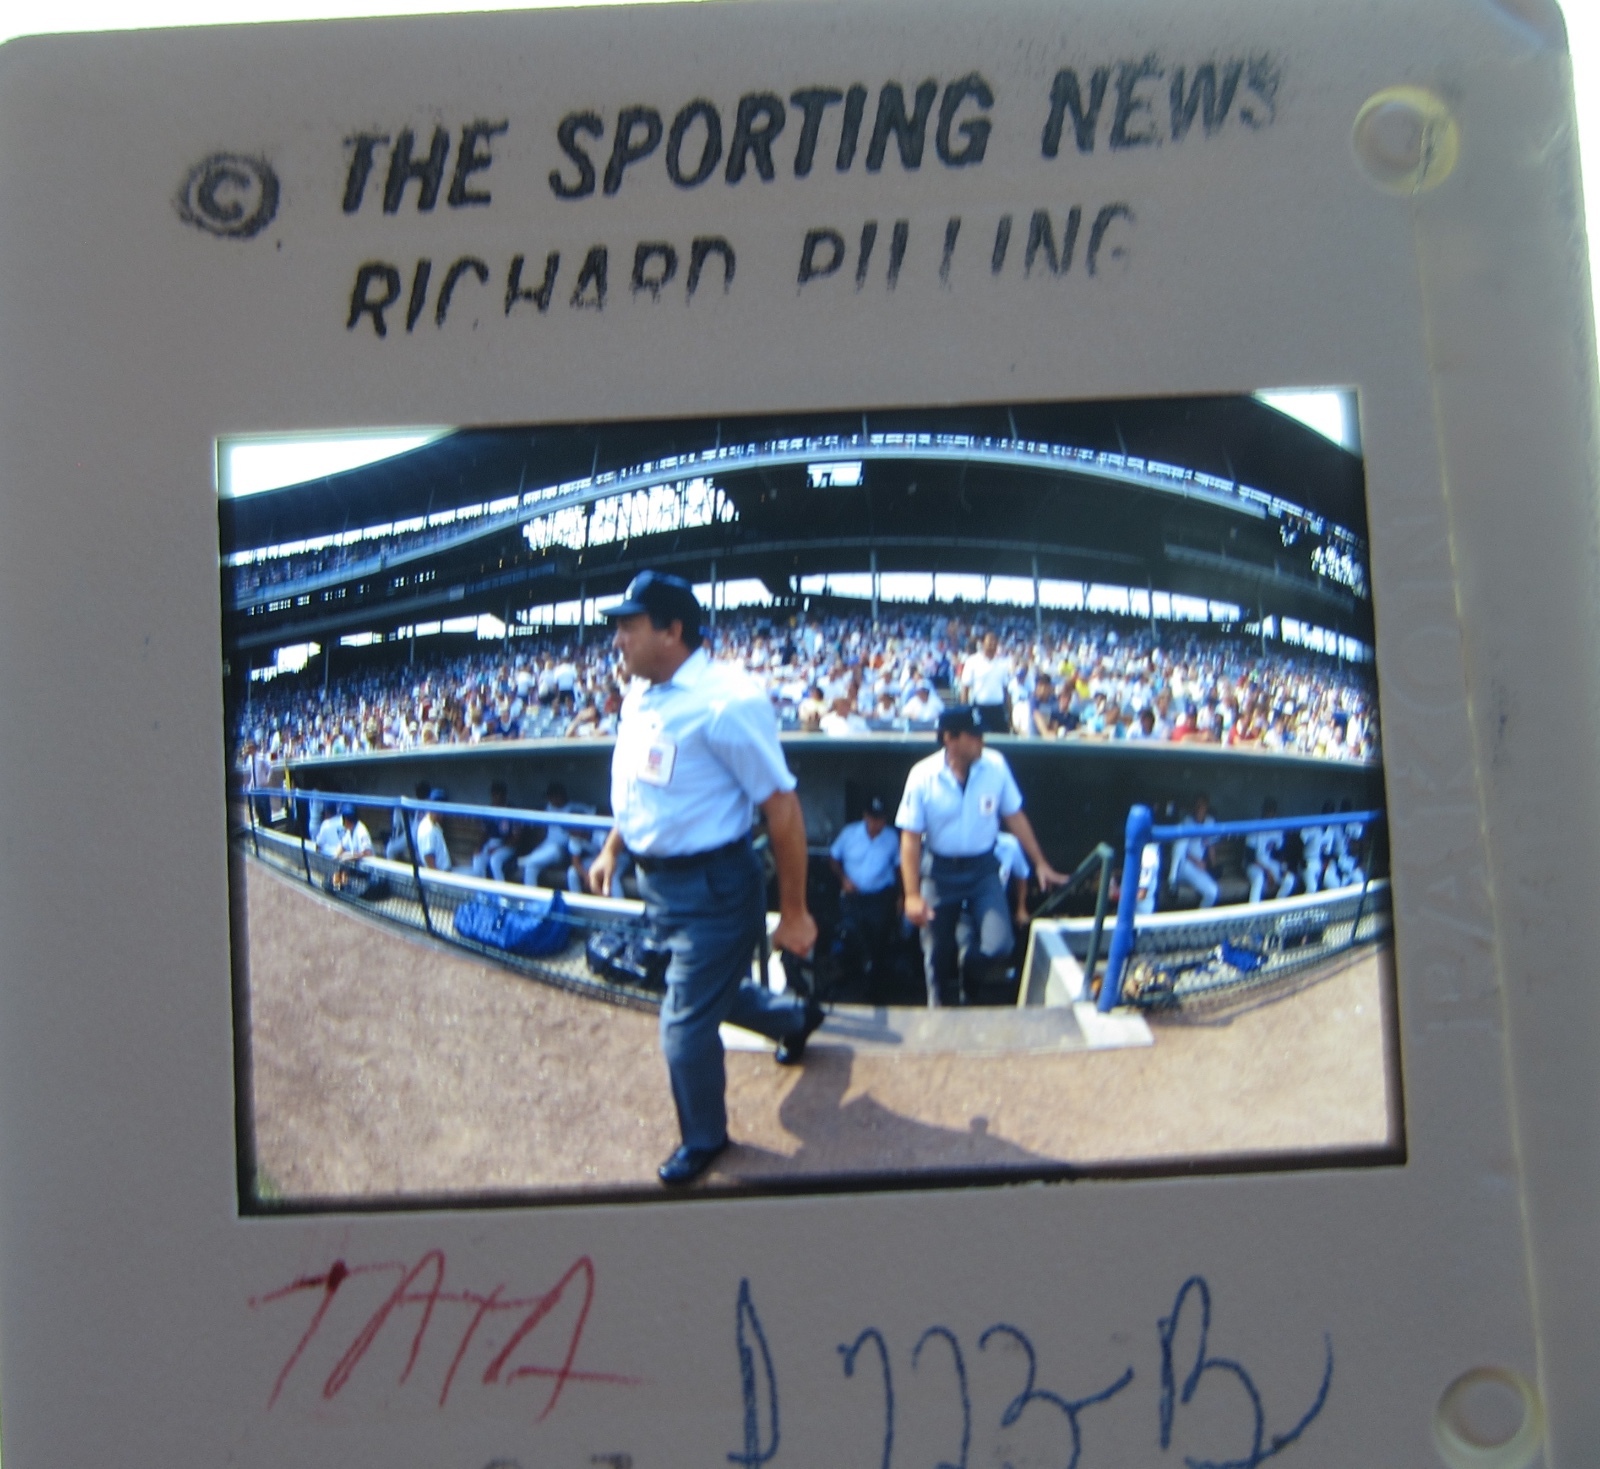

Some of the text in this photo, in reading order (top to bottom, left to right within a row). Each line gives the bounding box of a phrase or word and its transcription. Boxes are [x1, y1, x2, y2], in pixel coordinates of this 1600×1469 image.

[340, 117, 510, 216] THE
[548, 70, 995, 201] SPORTING
[1040, 52, 1280, 160] NEWS
